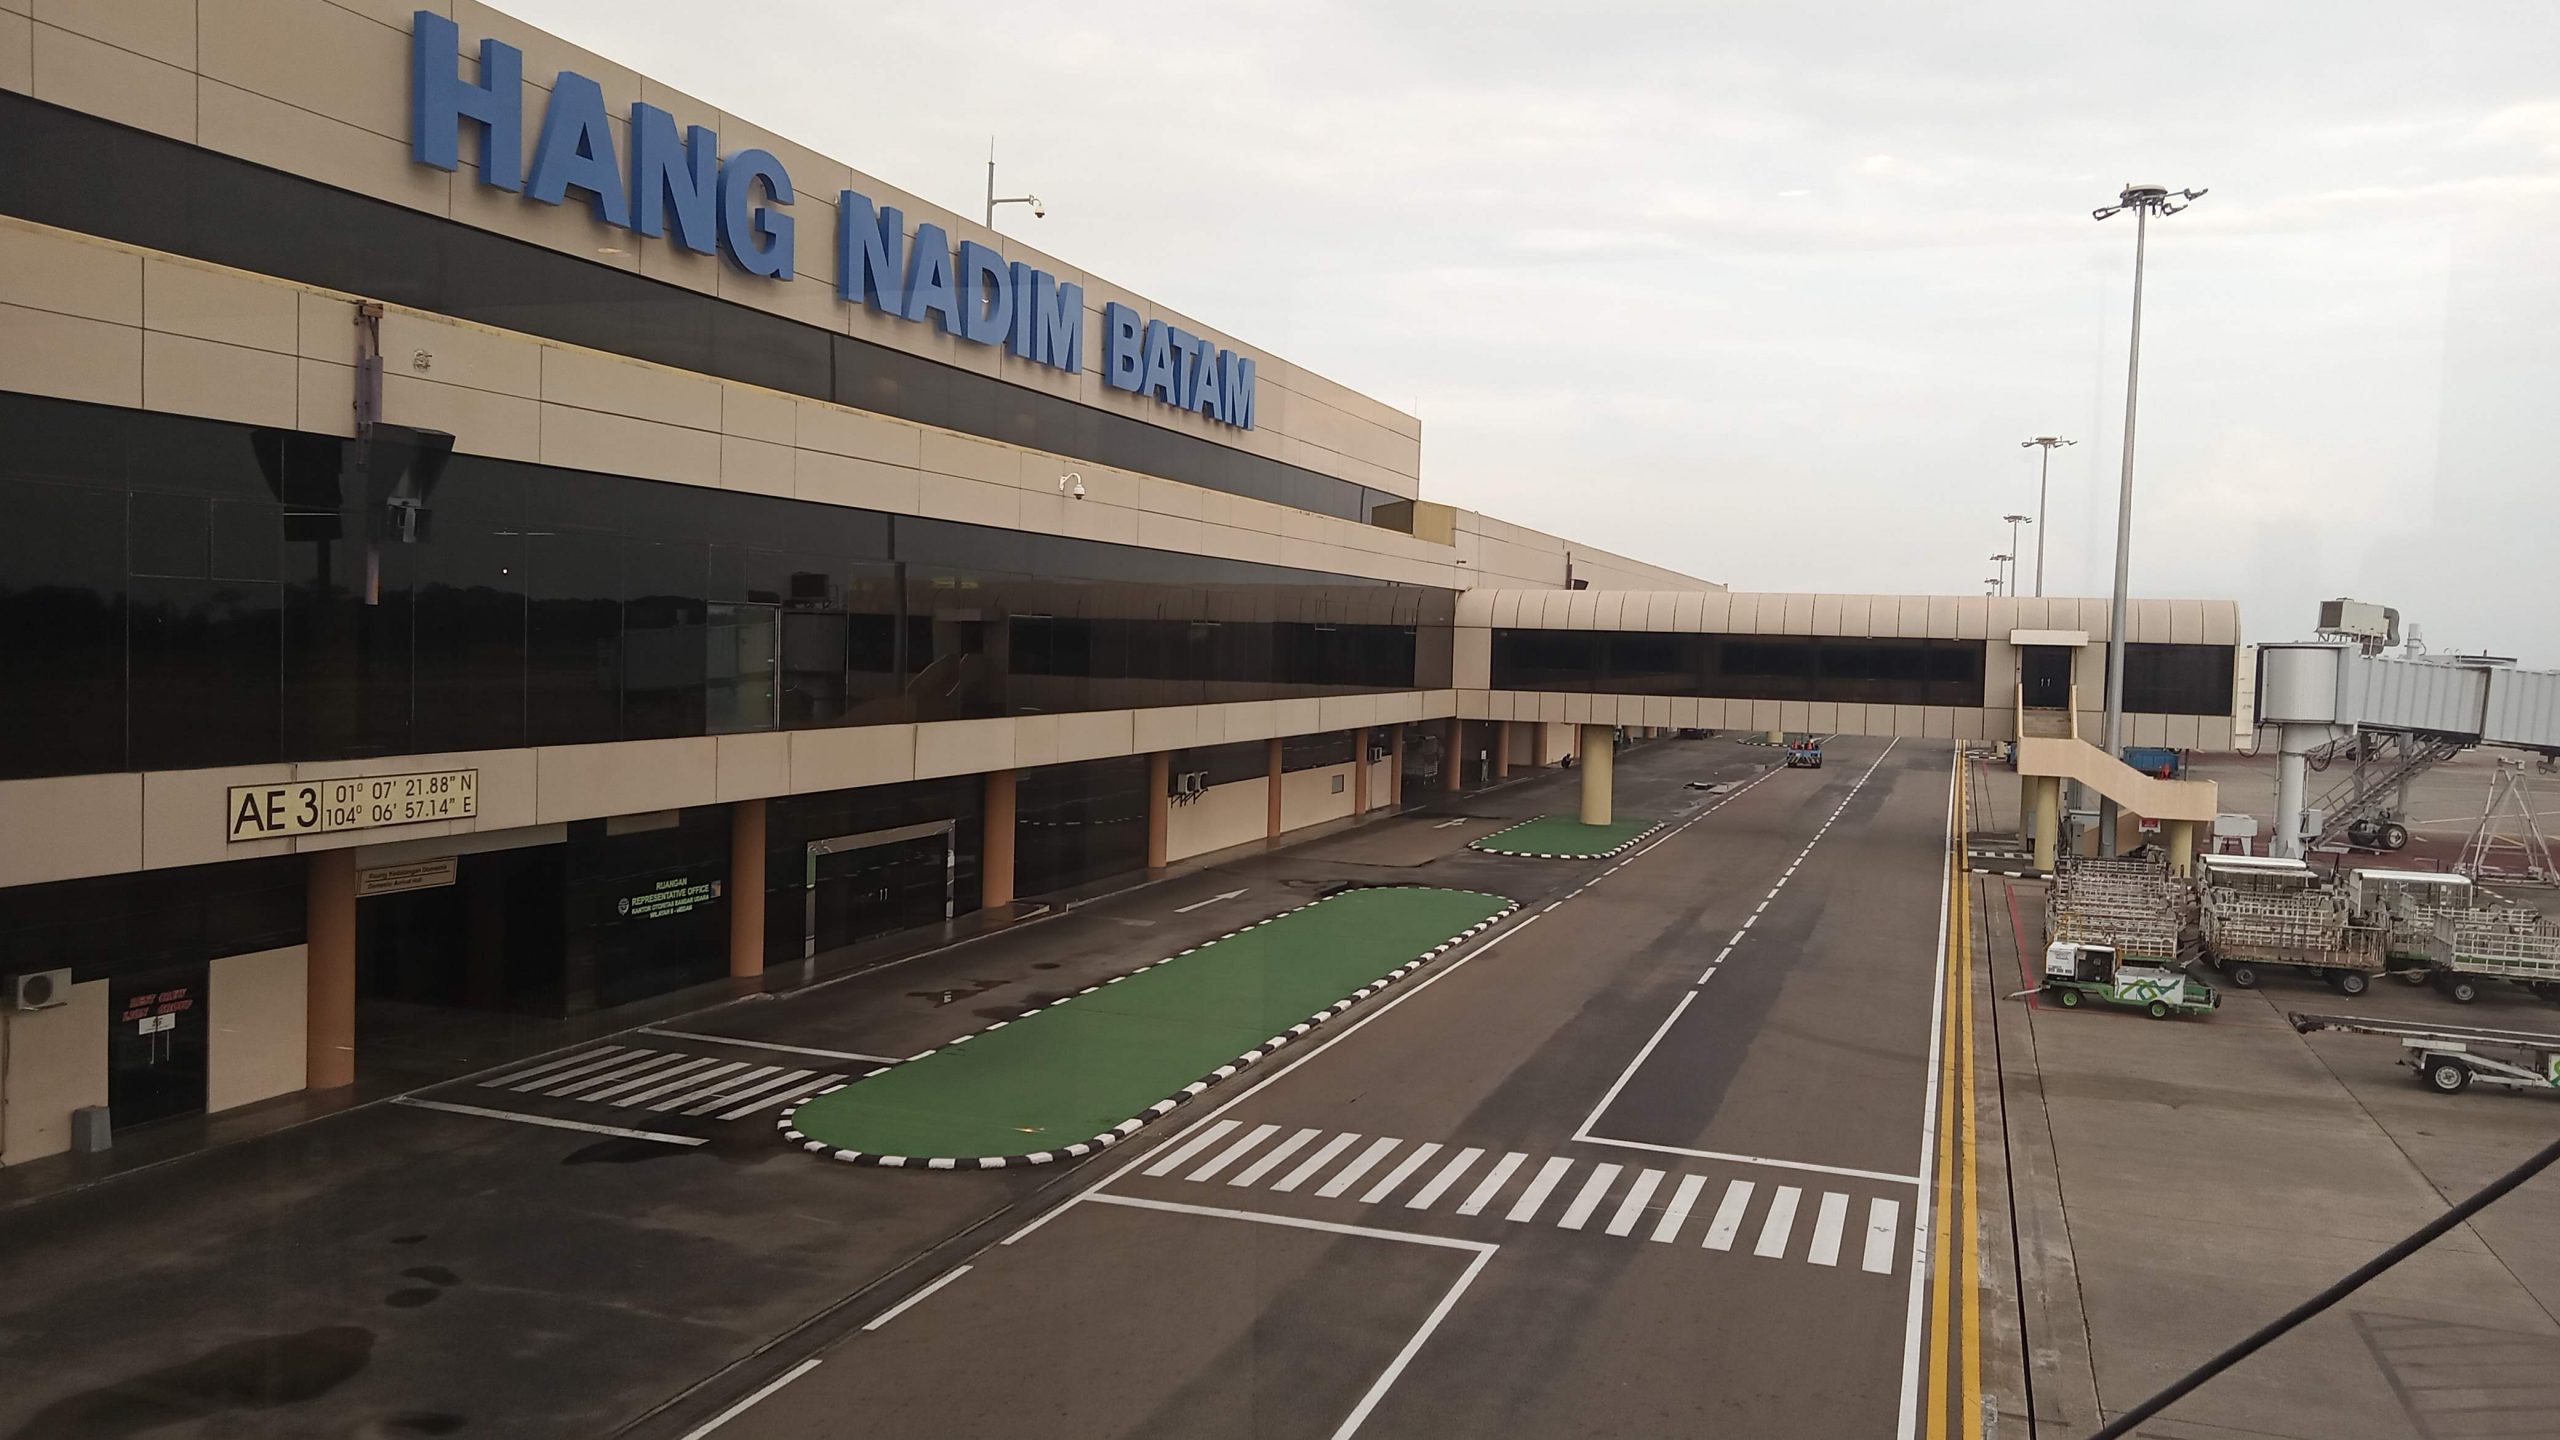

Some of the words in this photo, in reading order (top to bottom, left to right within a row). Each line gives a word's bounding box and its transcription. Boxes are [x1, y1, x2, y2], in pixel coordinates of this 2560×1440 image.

[414, 10, 794, 281] HANG
[839, 190, 1082, 374] NADIM
[1105, 301, 1255, 430] BATAM
[461, 775, 471, 791] N
[233, 791, 286, 834] AE
[297, 788, 318, 827] 3
[464, 797, 471, 813] E
[656, 877, 688, 891] RUANGAN
[631, 888, 687, 907] REPRESENTATIVE
[687, 884, 710, 897] OFFICE
